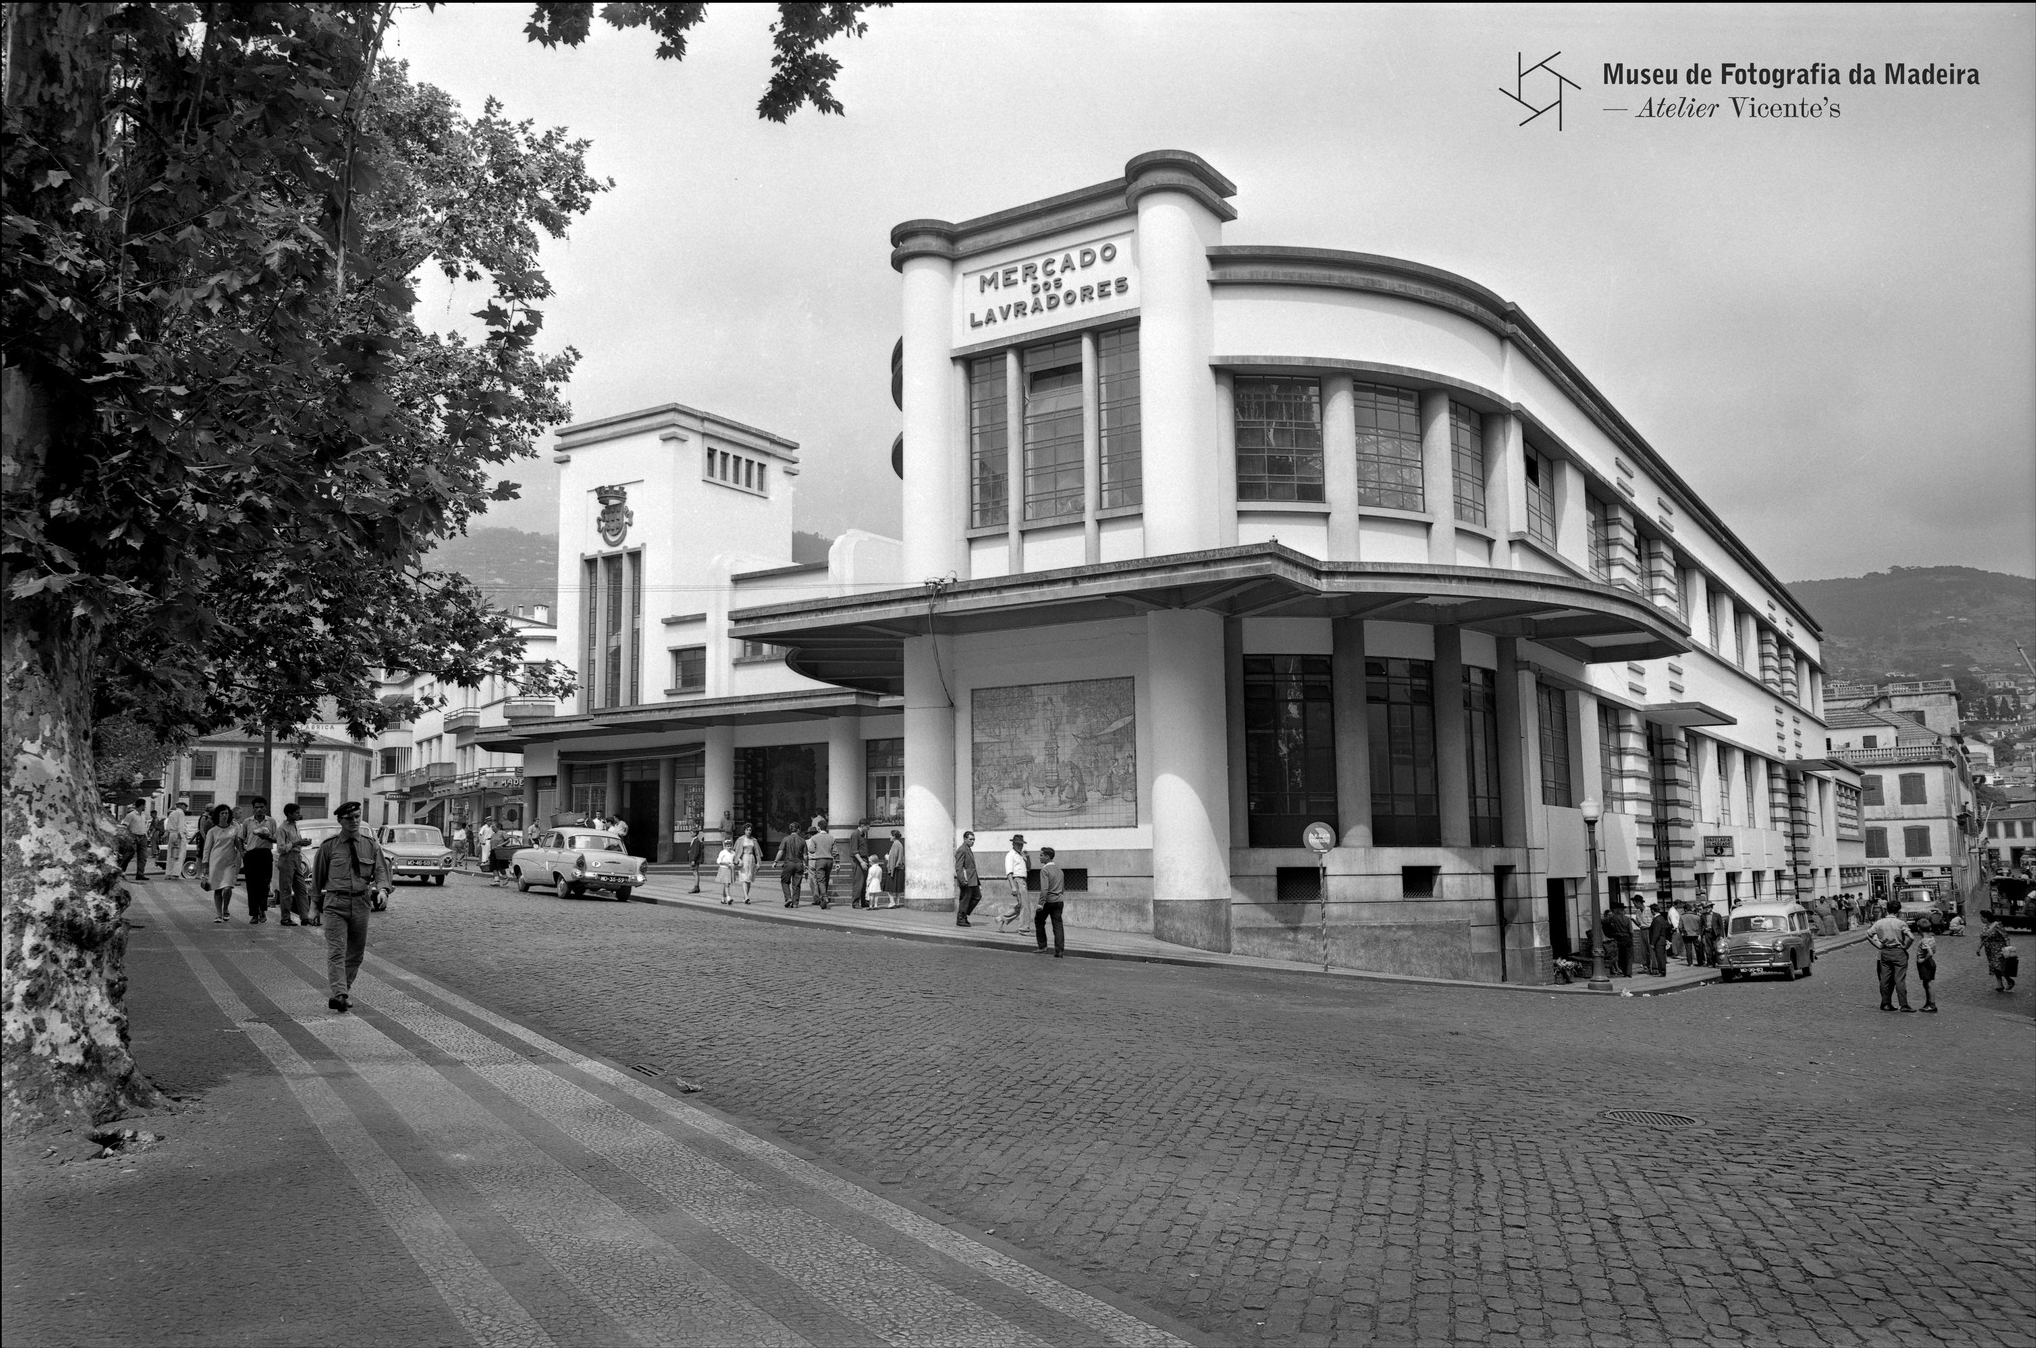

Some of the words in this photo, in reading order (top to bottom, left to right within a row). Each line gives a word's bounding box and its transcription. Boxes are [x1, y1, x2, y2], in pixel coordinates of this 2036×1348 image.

[979, 242, 1117, 293] MERCADO
[1030, 277, 1063, 295] DOS
[969, 276, 1129, 328] LAVRADORES
